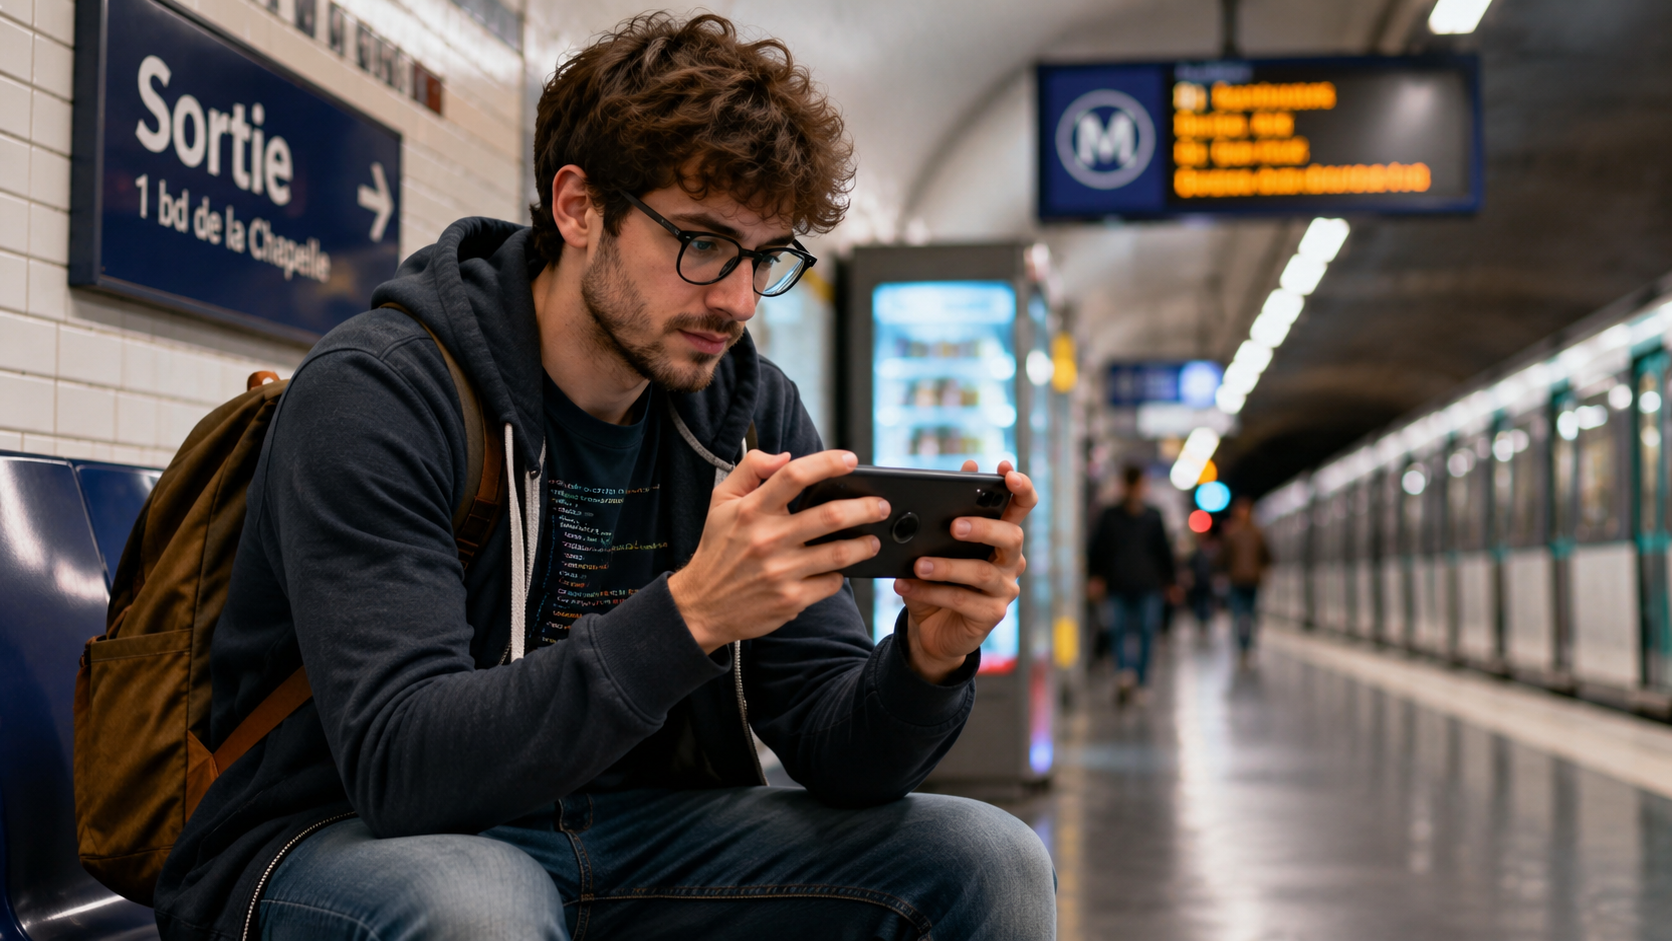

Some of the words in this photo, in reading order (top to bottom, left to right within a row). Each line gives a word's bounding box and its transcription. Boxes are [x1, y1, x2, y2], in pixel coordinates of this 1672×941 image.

[136, 55, 293, 206] Sortie
[136, 174, 149, 219] 1
[158, 180, 188, 233] bd
[194, 196, 222, 245] de
[225, 206, 246, 253] la
[249, 218, 331, 282] Chapelle
